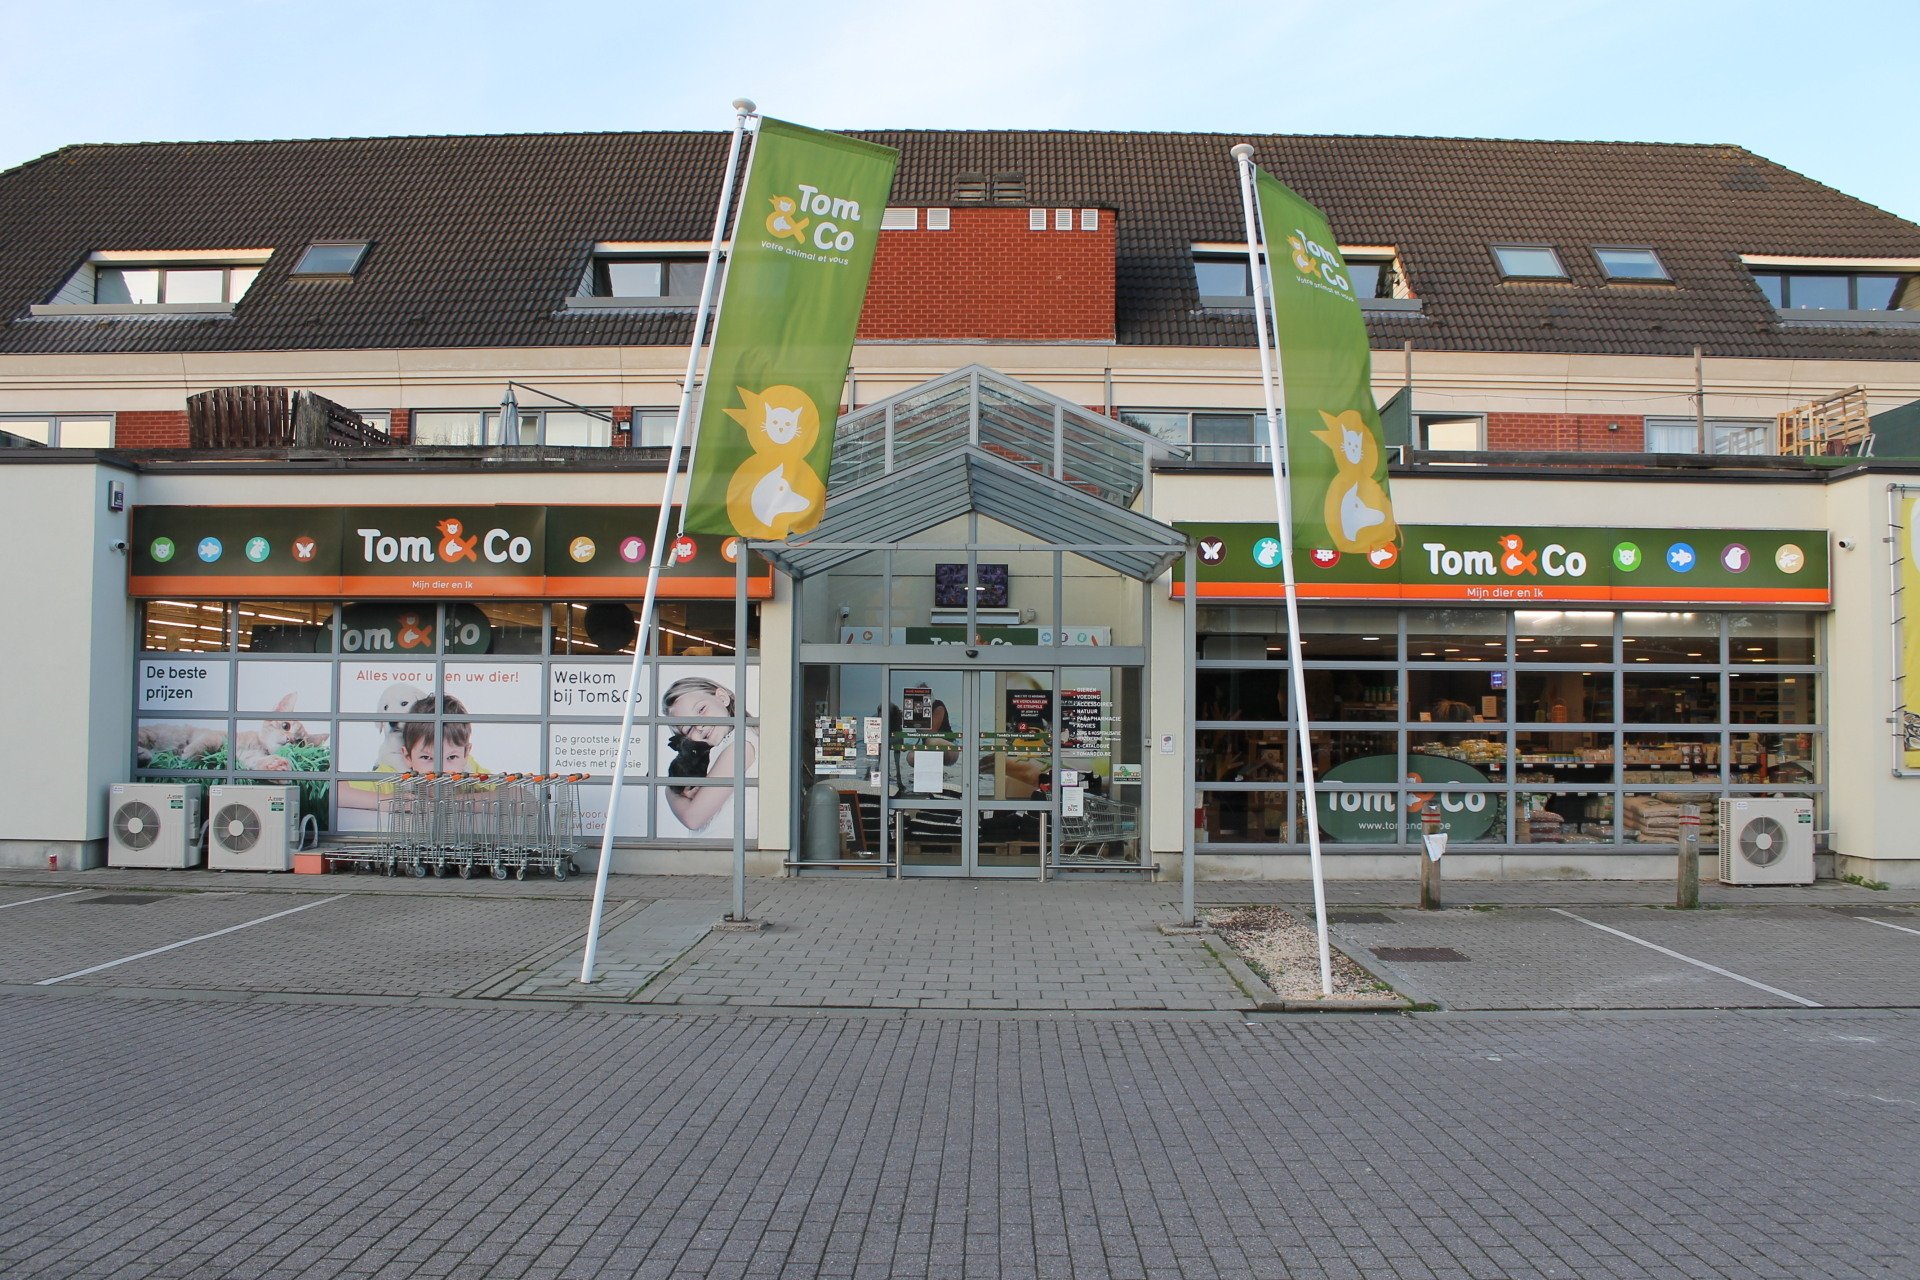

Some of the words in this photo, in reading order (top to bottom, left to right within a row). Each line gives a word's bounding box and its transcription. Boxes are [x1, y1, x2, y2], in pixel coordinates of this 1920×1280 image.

[798, 184, 861, 221] Tom
[813, 221, 855, 252] Co
[761, 240, 784, 252] Votre
[785, 247, 816, 261] animal
[817, 255, 827, 264] et
[829, 256, 849, 265] vous
[1295, 228, 1340, 268] Tom
[1321, 263, 1349, 291] Co
[357, 528, 435, 563] Tom
[483, 528, 532, 563] Co
[1423, 543, 1497, 576] Tom
[1541, 544, 1587, 577] Co
[412, 580, 430, 590] Mijn
[432, 580, 449, 589] dier
[465, 580, 473, 589] Ik
[1467, 588, 1489, 599] Mijn
[1492, 588, 1514, 597] dier
[1517, 590, 1531, 598] en
[1534, 588, 1544, 597] Ik
[146, 666, 165, 678] De
[169, 666, 207, 679] beste
[356, 670, 388, 681] Alles
[392, 672, 421, 681] voor
[426, 672, 433, 681] u
[445, 673, 460, 682] en
[466, 673, 484, 682] uw
[489, 671, 519, 682] dier!
[555, 671, 616, 684] Welkom
[146, 686, 193, 701] prijzen
[554, 689, 572, 706] bij
[555, 734, 568, 744] De
[570, 735, 610, 746] grootste
[555, 747, 568, 756] De
[570, 747, 596, 756] beste
[600, 747, 632, 757] prijzn
[555, 759, 587, 768] Advies
[590, 760, 607, 768] met
[580, 811, 601, 819] voor
